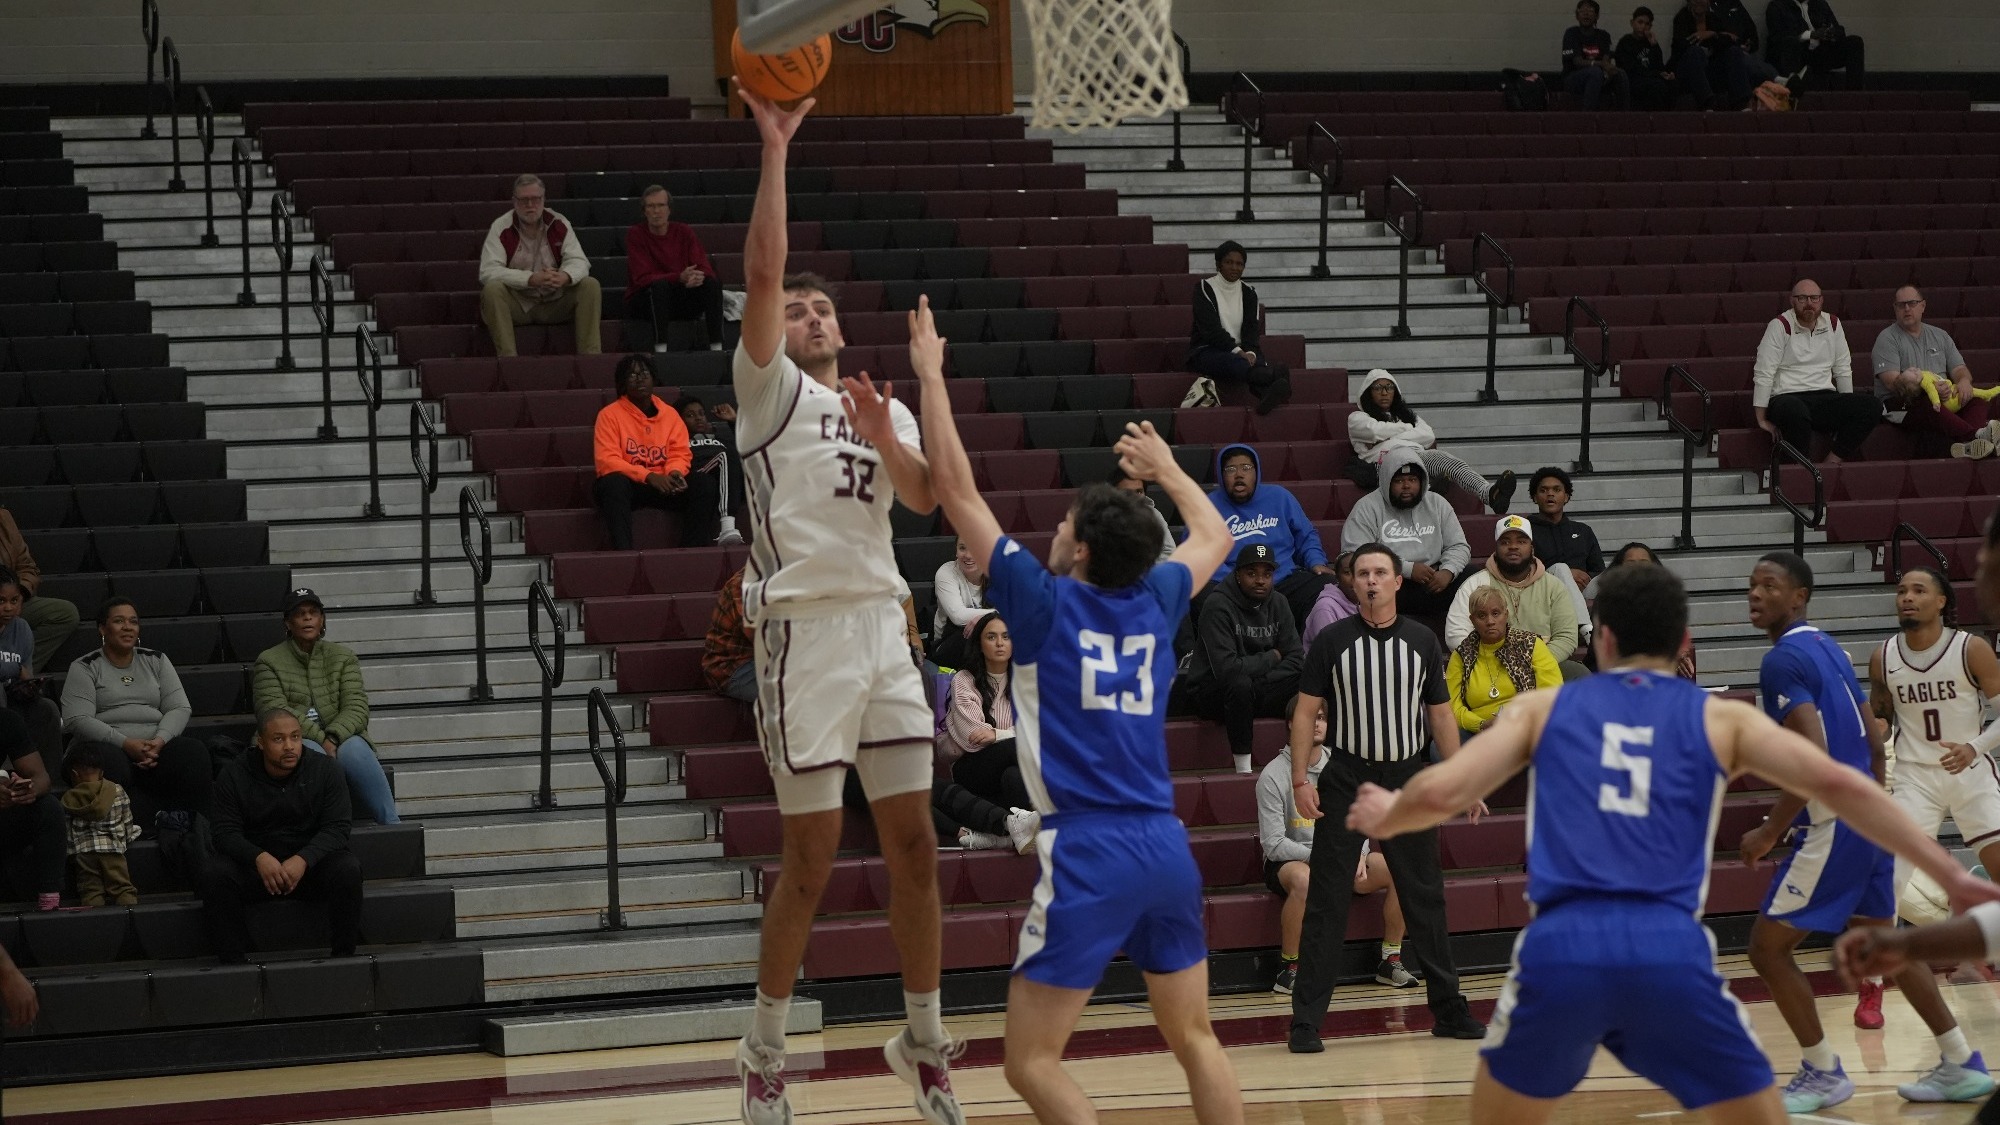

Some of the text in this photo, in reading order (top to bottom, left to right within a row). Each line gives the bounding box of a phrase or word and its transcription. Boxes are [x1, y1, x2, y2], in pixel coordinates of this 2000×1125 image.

[833, 451, 878, 505] 32
[1078, 628, 1156, 716] 23
[1896, 680, 1957, 704] EAGLES
[1923, 708, 1941, 742] 0
[1597, 721, 1655, 818] 5
